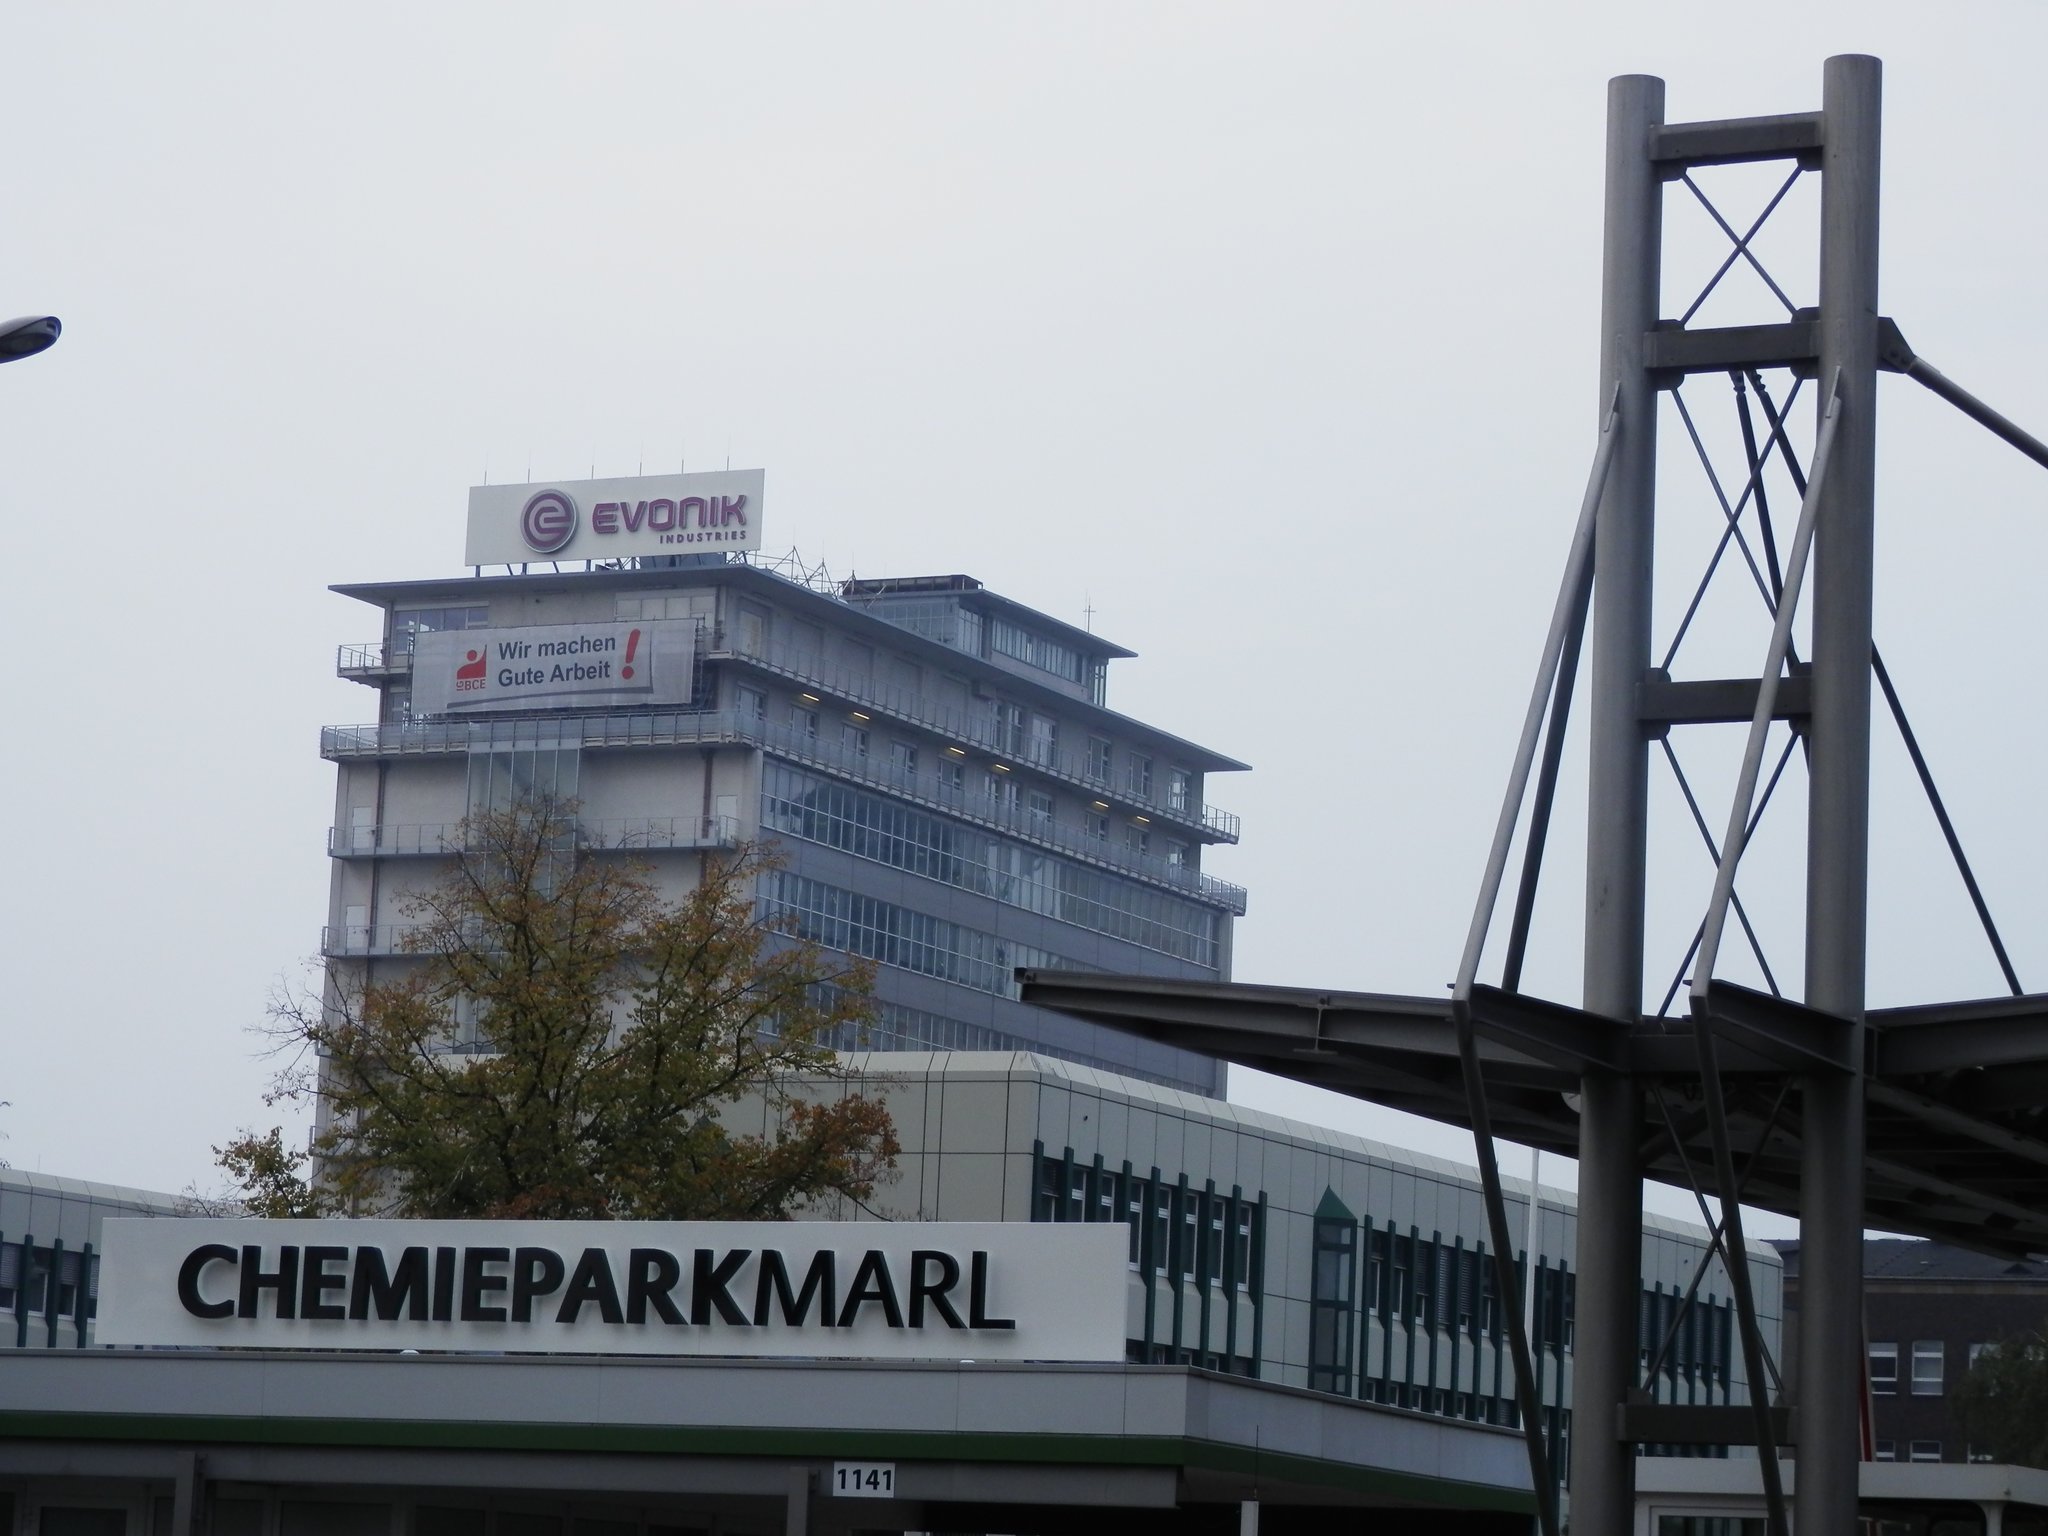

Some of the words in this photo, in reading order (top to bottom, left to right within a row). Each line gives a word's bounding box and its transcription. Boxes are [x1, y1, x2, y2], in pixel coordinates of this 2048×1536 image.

[592, 494, 747, 534] EVONIK
[659, 530, 747, 544] INDUSTRIES
[498, 641, 532, 660] Wir
[537, 635, 616, 657] machen
[498, 667, 545, 688] Gute
[549, 660, 611, 682] Arbeit
[837, 1468, 892, 1491] 1141
